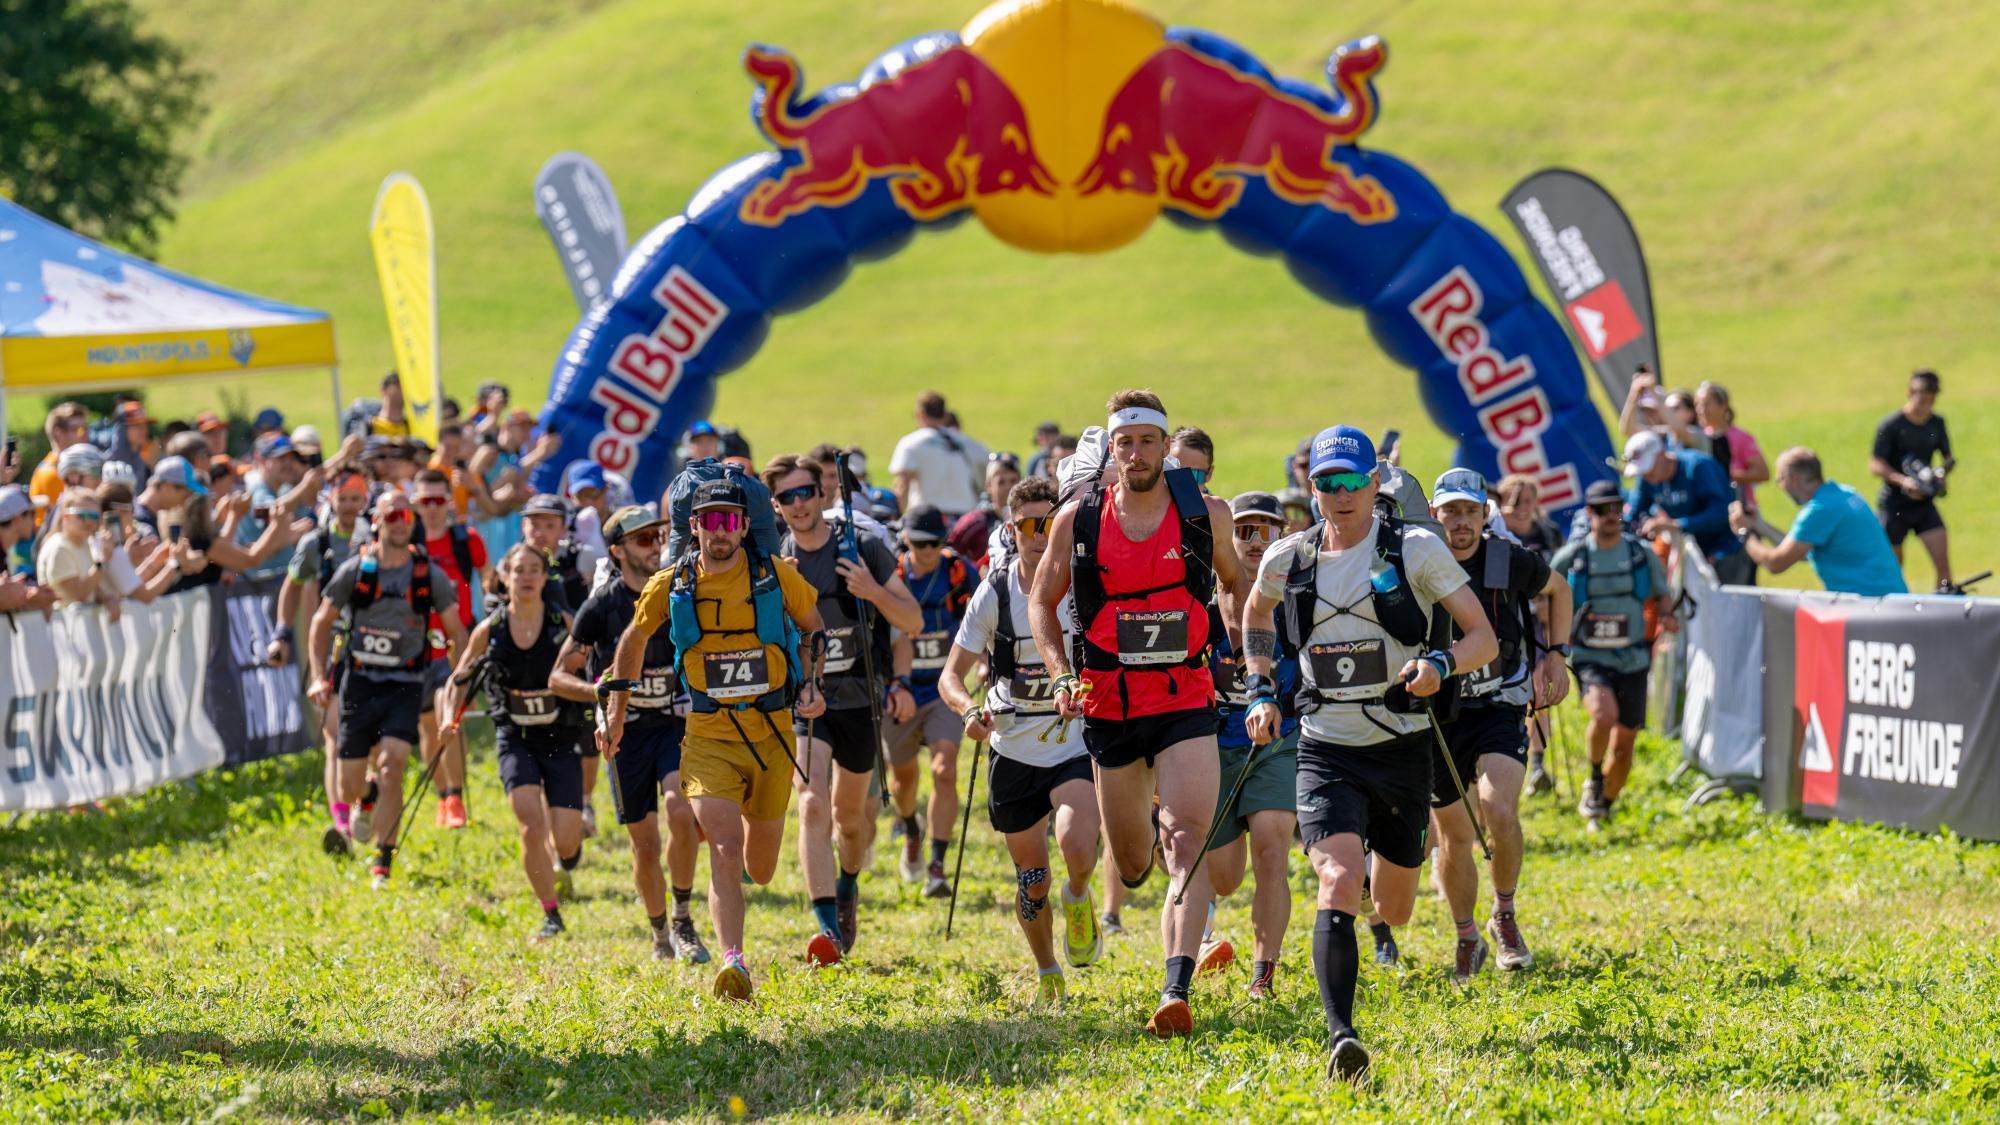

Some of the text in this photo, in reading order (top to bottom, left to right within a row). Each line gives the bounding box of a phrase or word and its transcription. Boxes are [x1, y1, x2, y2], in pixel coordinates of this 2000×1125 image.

[608, 264, 731, 403] Bull
[1409, 266, 1582, 513] Red Bull
[575, 375, 662, 495] ed
[1316, 436, 1359, 451] ERDINGER
[363, 634, 393, 655] 90
[1143, 625, 1160, 648] 7
[825, 638, 844, 659] 2
[916, 639, 941, 658] 15
[720, 661, 754, 685] 74
[1336, 656, 1356, 683] 9
[1848, 639, 1917, 711] BERG
[1024, 677, 1054, 698] 77
[524, 696, 545, 714] 11
[1842, 712, 1964, 789] FREUNDE
